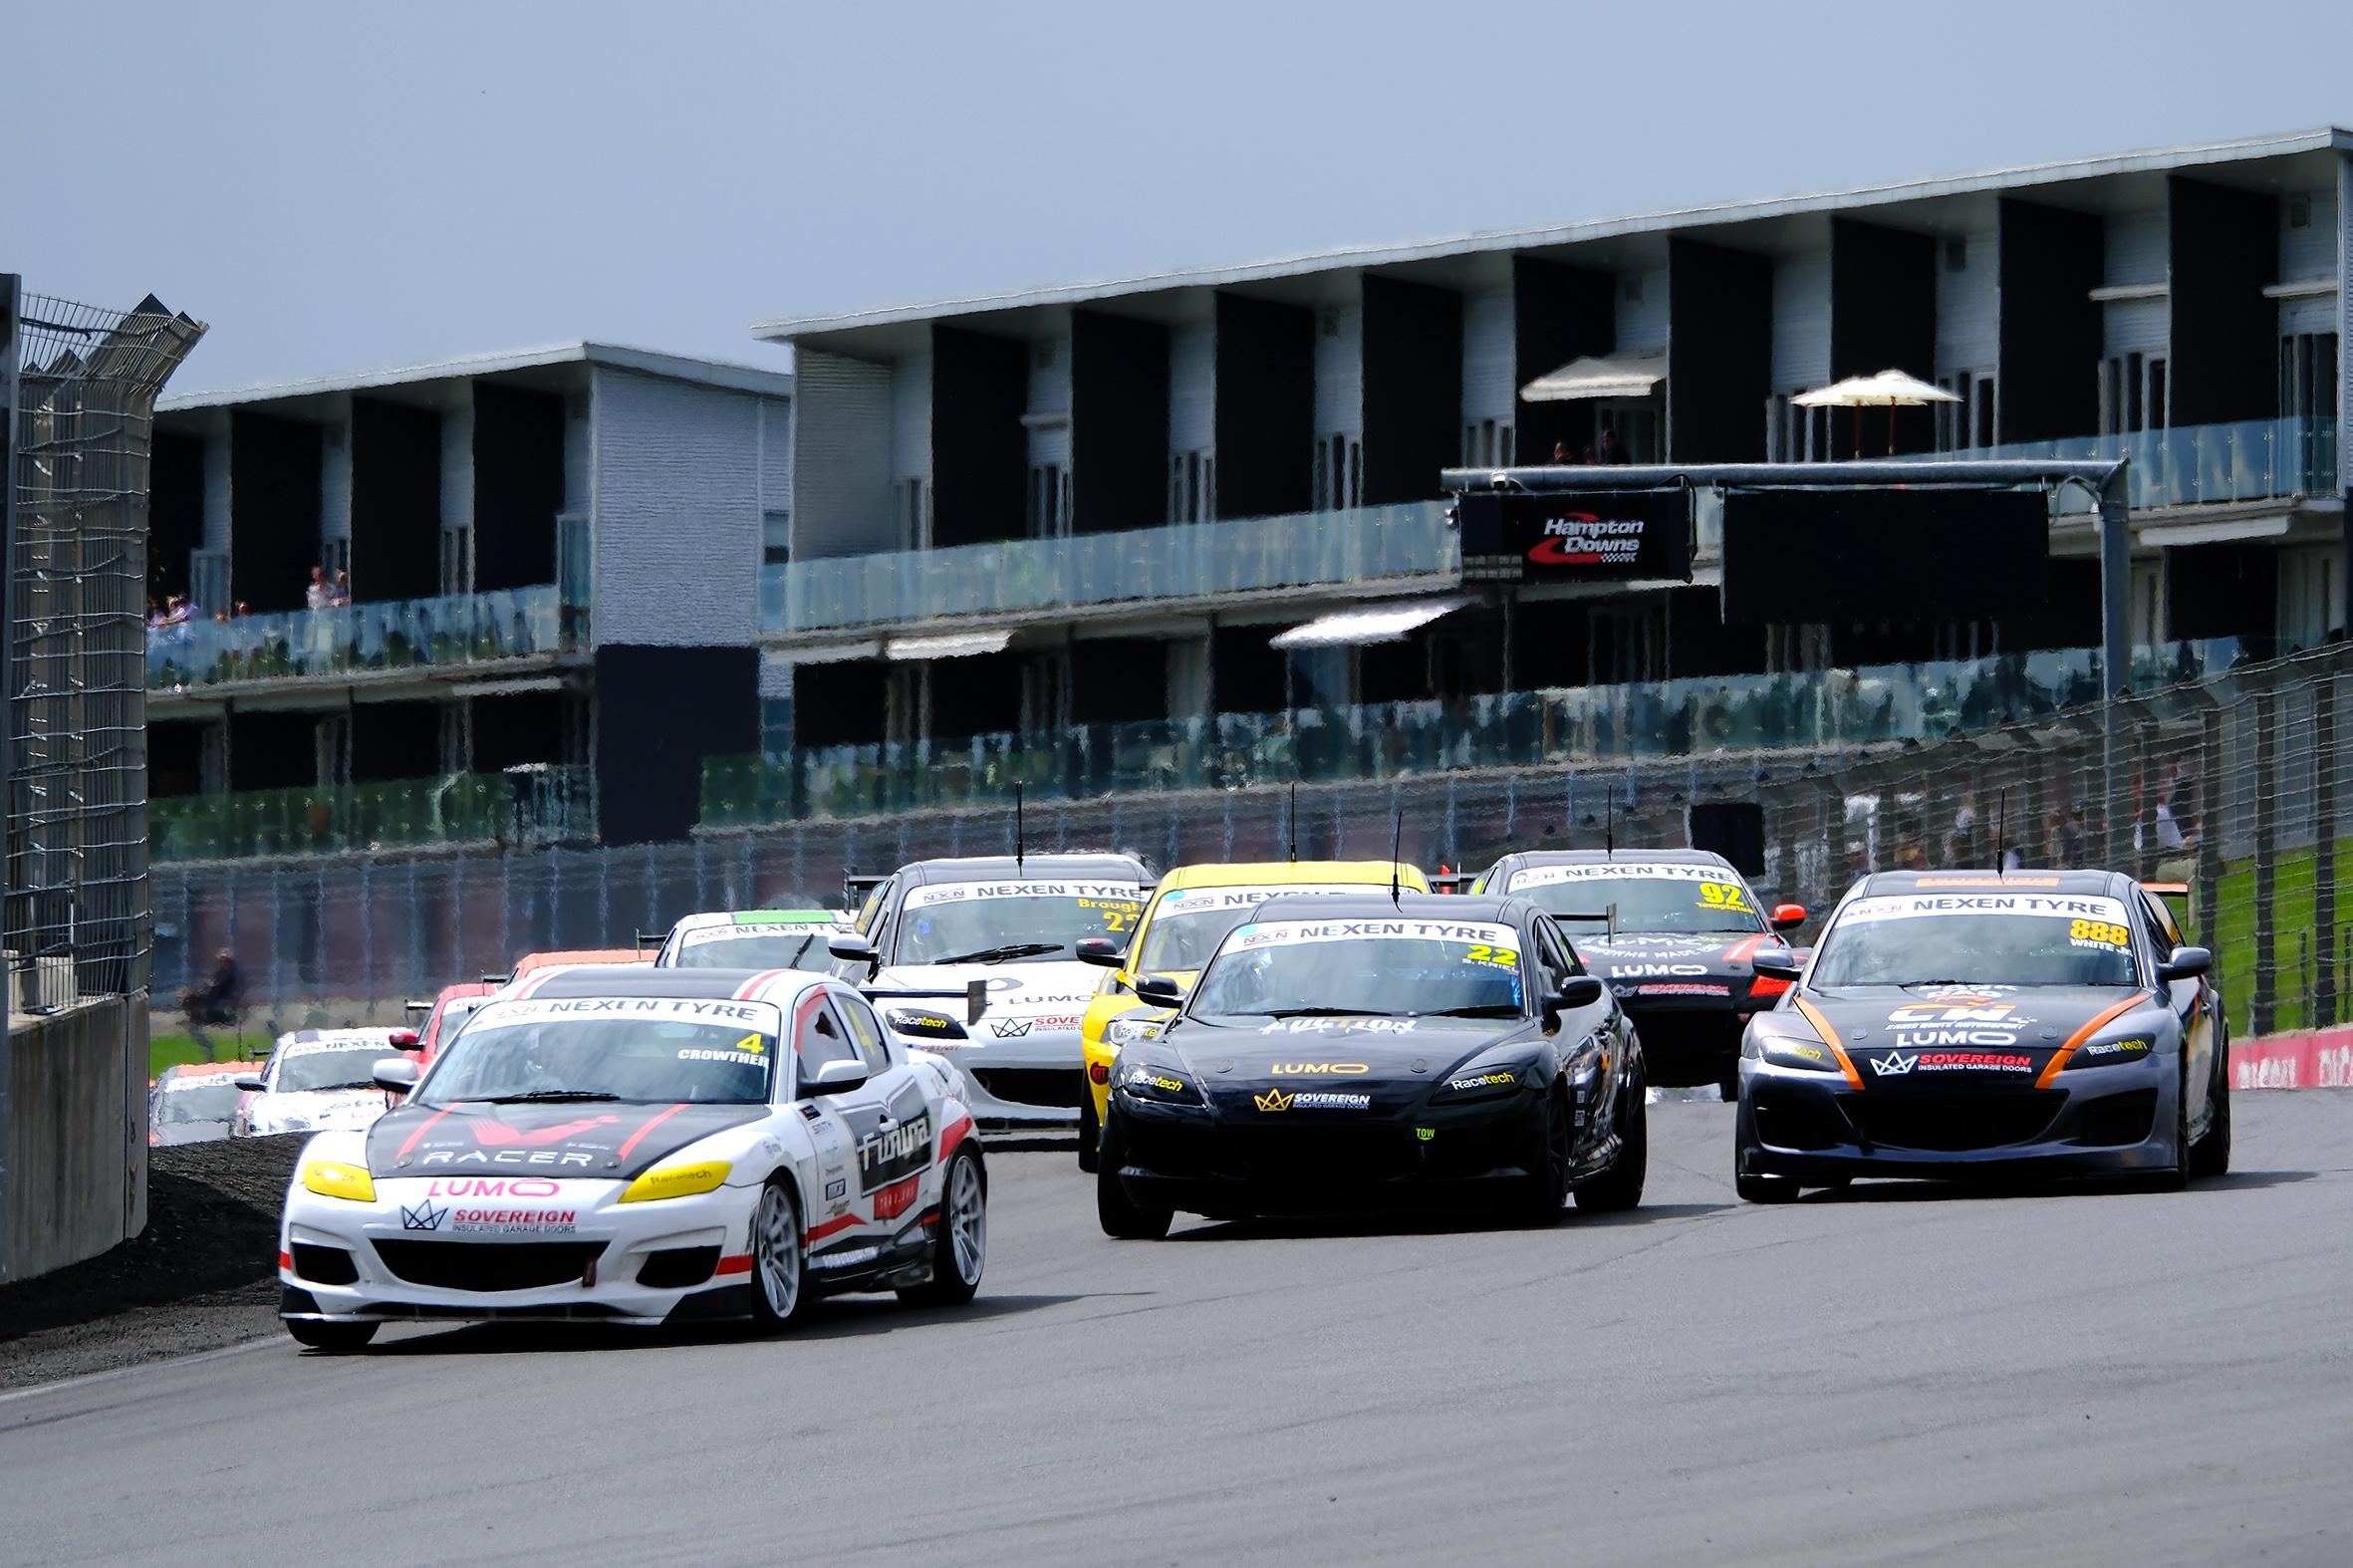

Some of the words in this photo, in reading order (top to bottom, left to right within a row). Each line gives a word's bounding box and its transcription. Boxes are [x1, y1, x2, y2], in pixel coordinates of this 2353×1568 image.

[1544, 518, 1644, 539] Hampton
[1565, 536, 1640, 553] Downs
[1565, 867, 1655, 877] NEXEN
[1658, 867, 1733, 882] TYRE
[977, 885, 1066, 897] NEXEN
[1075, 885, 1144, 900] TYRE
[1699, 882, 1745, 908] 92
[1913, 898, 2015, 911] NEXEN
[2025, 898, 2107, 915] TYRE
[734, 923, 809, 934] NEXEN
[1300, 922, 1405, 937] NEXEN
[1414, 922, 1497, 941] TYRE
[2070, 918, 2129, 946] 888
[1466, 944, 1518, 966] 22
[1611, 964, 1708, 978] LUMO
[549, 1000, 658, 1013] NEXEN
[668, 1000, 758, 1021] TYRE
[736, 1033, 764, 1055] 4
[1896, 1030, 2017, 1048] LUMO
[2087, 1038, 2149, 1056] Racetech
[677, 1048, 769, 1068] CROWTHER
[1919, 1053, 2032, 1066] SOVEREIGN
[1271, 1063, 1370, 1074] LUMO
[2002, 1065, 2033, 1074] DOORS
[1129, 1072, 1183, 1092] Racetech
[1451, 1073, 1515, 1091] Racetech
[1293, 1093, 1371, 1105] SOVEREIGN
[1416, 1128, 1435, 1139] TOW
[422, 1150, 594, 1168] RACER
[428, 1179, 561, 1197] LUMO
[453, 1208, 576, 1223] SOVEREIGN
